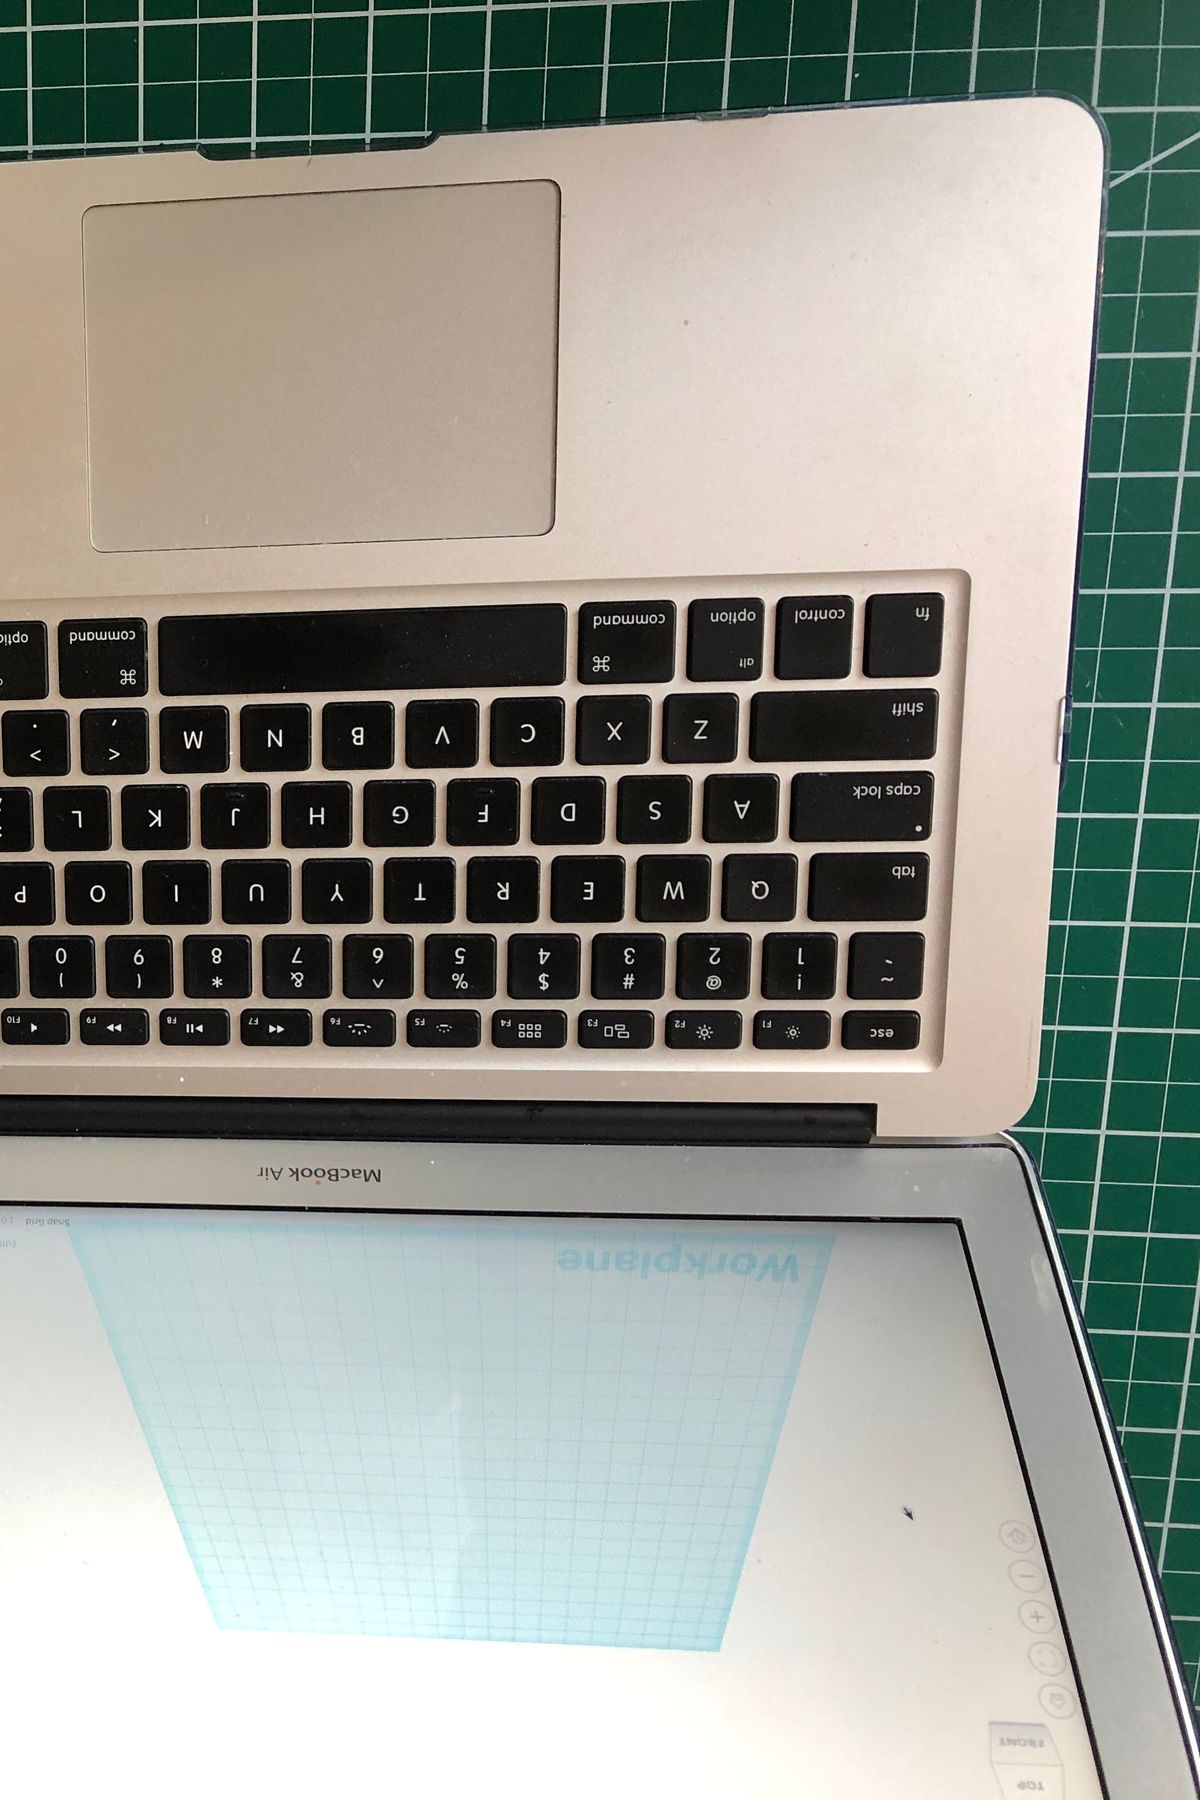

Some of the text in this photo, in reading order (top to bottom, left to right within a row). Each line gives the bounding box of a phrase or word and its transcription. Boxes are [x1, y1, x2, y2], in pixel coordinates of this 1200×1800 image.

[593, 613, 666, 629] command
[710, 608, 756, 625] option
[794, 608, 846, 624] control
[915, 606, 930, 622] fn
[69, 630, 136, 645] command
[739, 657, 755, 669] alt
[891, 702, 924, 717] shift
[267, 729, 283, 748] N
[351, 726, 364, 746] B
[435, 725, 450, 745] V
[520, 723, 536, 743] C
[606, 721, 623, 741] X
[693, 720, 709, 740] Z
[183, 730, 204, 750] M
[852, 782, 921, 800] caps lock
[148, 809, 162, 828] K
[231, 808, 241, 827] J
[309, 806, 325, 825] H
[392, 805, 409, 824] G
[477, 804, 489, 823] F
[560, 802, 576, 822] D
[648, 801, 662, 821] S
[733, 800, 751, 820] A
[71, 810, 82, 829] L
[891, 866, 916, 880] tab
[14, 885, 27, 903] P
[89, 884, 106, 903] O
[249, 883, 264, 902] U
[330, 883, 344, 902] Y
[414, 882, 427, 901] T
[496, 881, 510, 901] R
[583, 881, 594, 901] E
[662, 881, 685, 900] W
[751, 880, 770, 900] Q
[55, 947, 67, 964] 0
[133, 948, 145, 966] 9
[211, 947, 223, 964] 8
[291, 947, 303, 964] 7
[372, 947, 384, 964] 6
[454, 947, 466, 965] 5
[538, 947, 551, 965] 4
[623, 947, 636, 965] 3
[709, 947, 721, 965] 2
[6, 1015, 21, 1024] F10
[86, 1016, 97, 1024] F9
[166, 1016, 177, 1025] F8
[248, 1017, 259, 1026] F7
[330, 1017, 341, 1026] F6
[414, 1017, 426, 1026] F5
[500, 1019, 512, 1027] F4
[587, 1018, 599, 1027] F3
[674, 1019, 686, 1029] F2
[762, 1020, 772, 1029] F1
[869, 1028, 894, 1038] esc
[256, 1166, 383, 1182] MacBook Air
[556, 1239, 800, 1283] Workplane
